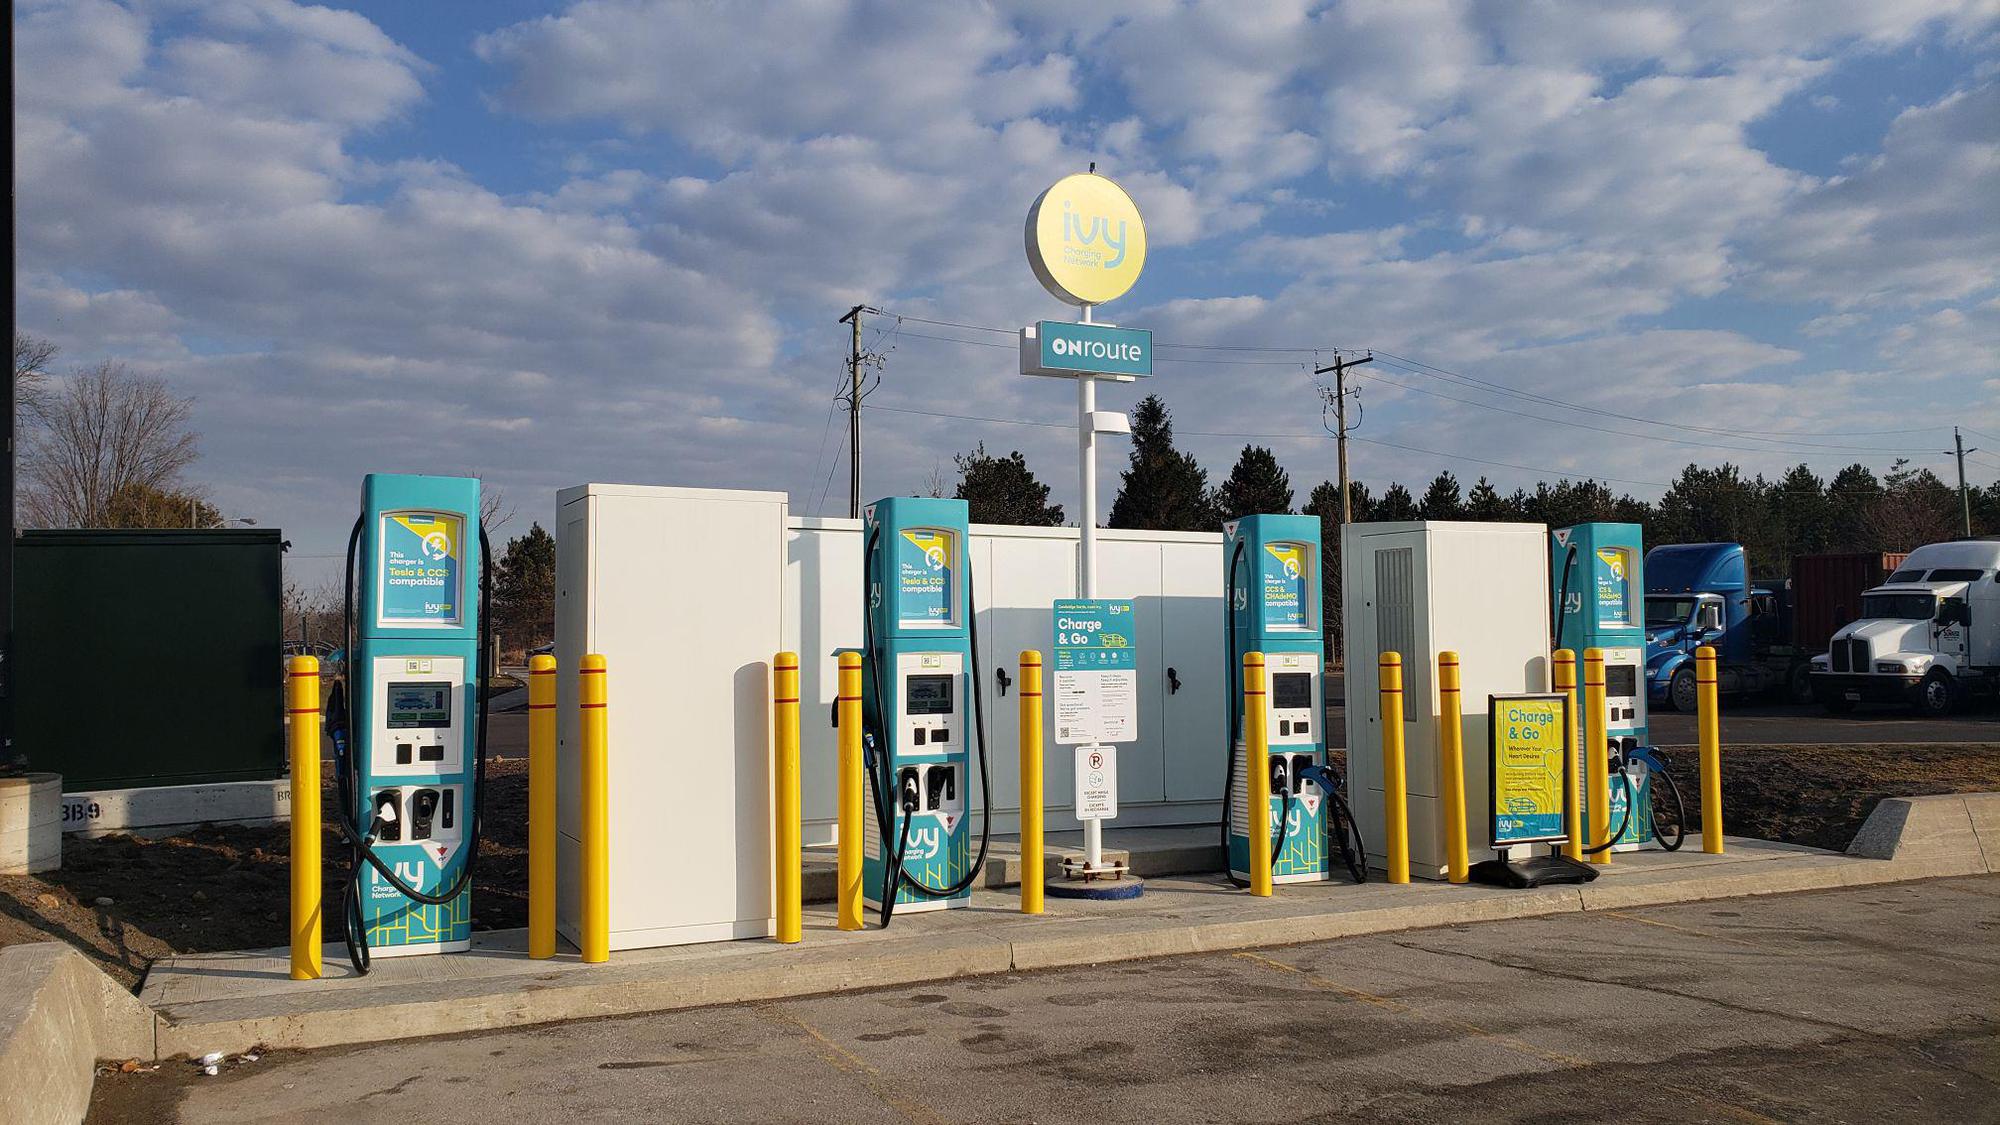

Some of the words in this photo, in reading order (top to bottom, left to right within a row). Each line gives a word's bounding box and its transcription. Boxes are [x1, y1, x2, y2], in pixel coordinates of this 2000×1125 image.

[1064, 200, 1126, 269] ivy
[1064, 247, 1101, 261] Charging
[1064, 256, 1099, 268] Network
[1052, 338, 1142, 361] ONroute
[389, 567, 415, 577] Tesla
[417, 568, 424, 577] &
[427, 568, 449, 577] CCS
[389, 577, 445, 587] compatible
[1265, 600, 1299, 608] compatible
[1058, 617, 1102, 633] Charge
[1058, 632, 1069, 645] &
[1070, 632, 1088, 645] Go
[1509, 709, 1553, 726] Charge
[1509, 726, 1519, 740] &
[1522, 727, 1540, 740] Go
[1499, 818, 1512, 832] ivy
